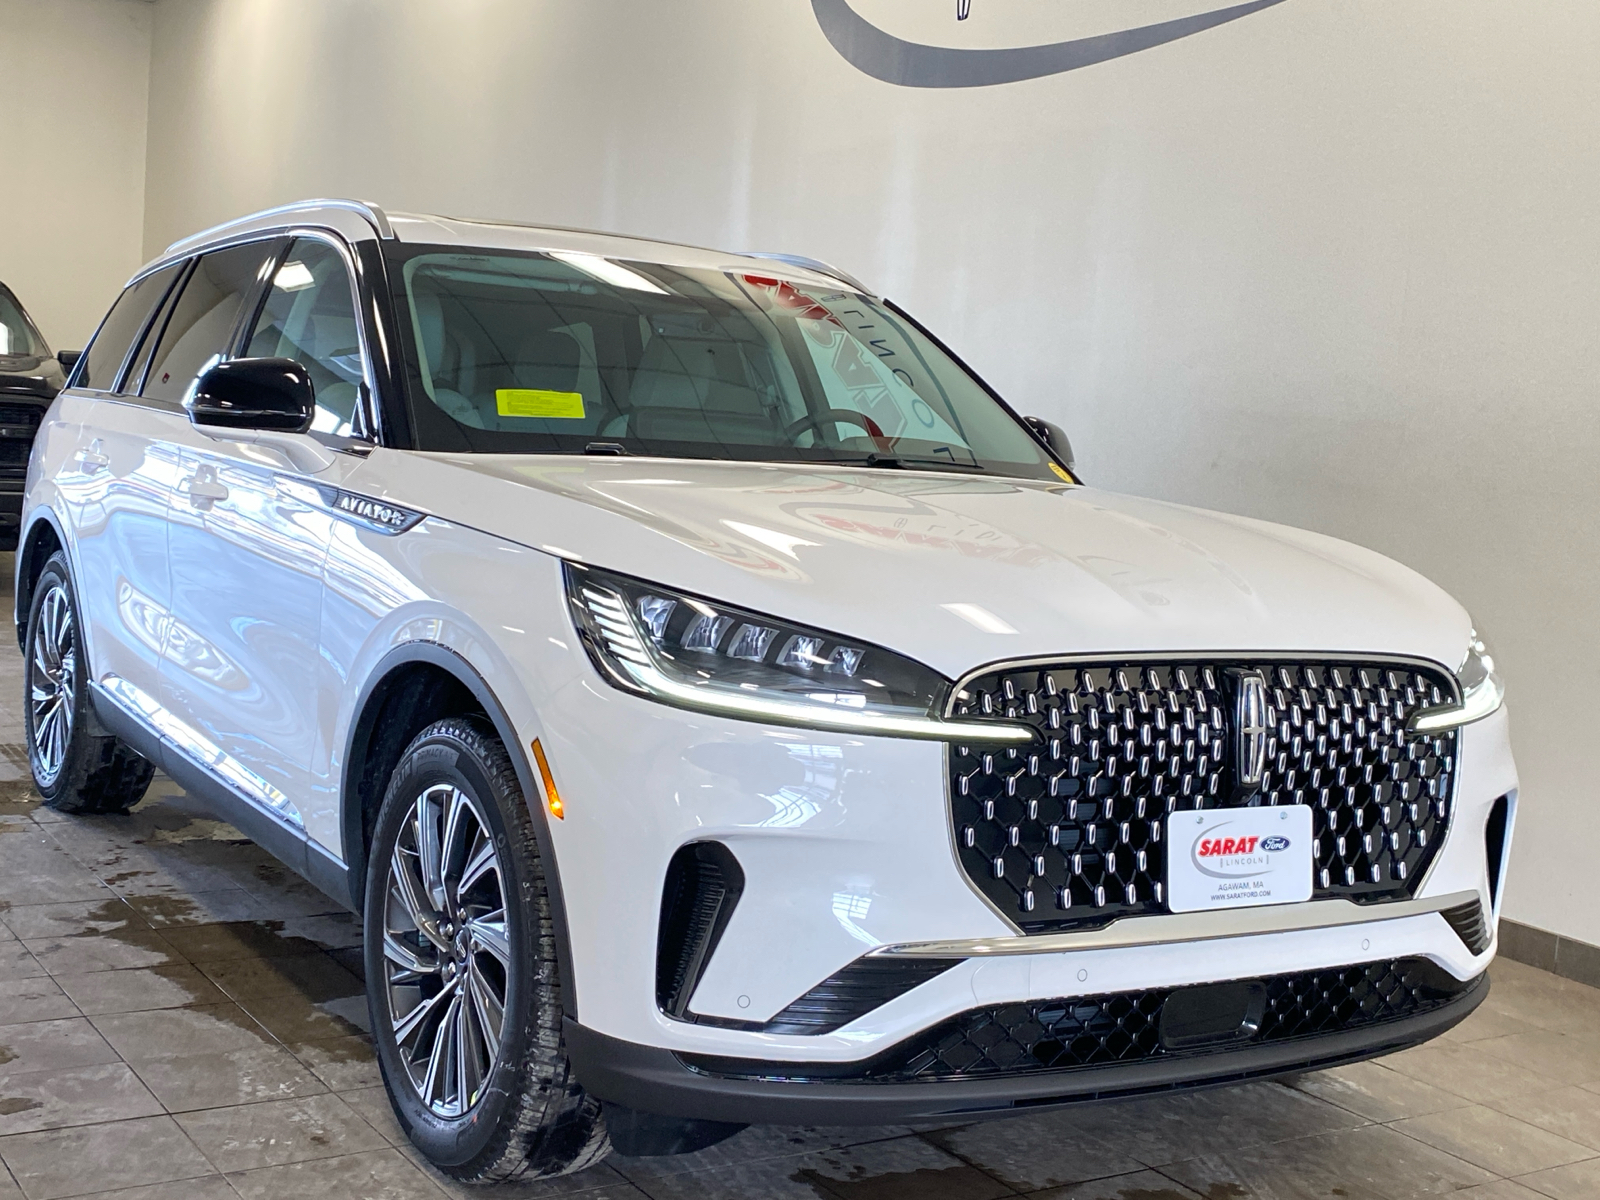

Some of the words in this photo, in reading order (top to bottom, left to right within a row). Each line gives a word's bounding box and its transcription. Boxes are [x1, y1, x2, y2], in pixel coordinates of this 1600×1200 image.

[340, 495, 405, 525] AVIATOR
[1198, 836, 1259, 857] SARAT
[1264, 838, 1286, 850] Ford
[1226, 857, 1263, 866] LINCOLN
[1218, 882, 1251, 891] AGAWAM,
[1253, 881, 1264, 889] MA
[1211, 890, 1271, 901] WWW.SARATFORD.COM
